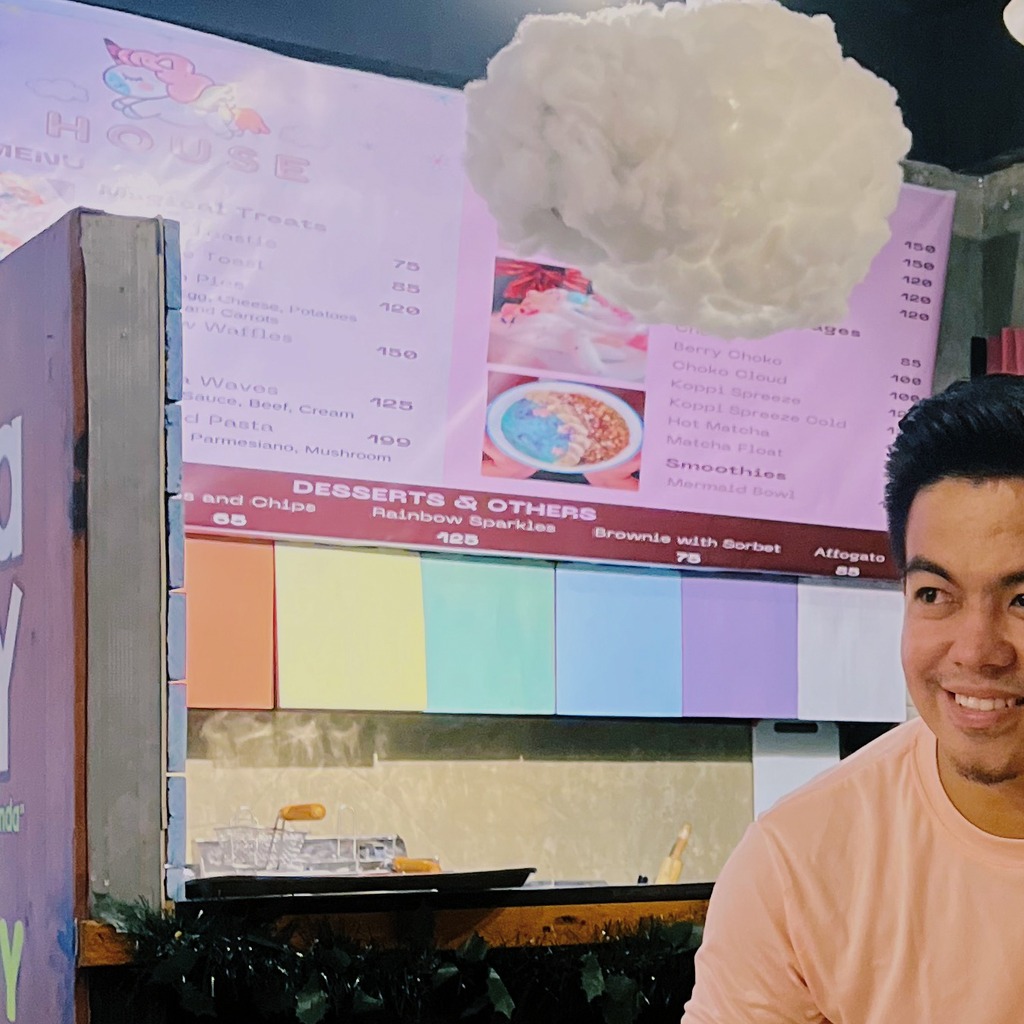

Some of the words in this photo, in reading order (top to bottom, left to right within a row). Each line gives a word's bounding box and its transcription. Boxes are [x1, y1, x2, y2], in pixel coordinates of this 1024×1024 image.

[46, 111, 311, 184] HOUSE
[236, 206, 328, 232] Treats
[904, 241, 936, 254] 150
[393, 259, 420, 272] 75
[903, 259, 935, 271] 150
[902, 276, 932, 288] 120
[187, 291, 213, 303] gg,
[901, 293, 931, 305] 120
[221, 308, 279, 325] Carrots
[379, 302, 420, 316] 120
[900, 309, 929, 321] 120
[205, 321, 292, 343] Waffles
[376, 346, 418, 360] 150
[674, 341, 721, 358] Berry
[728, 350, 782, 366] Choko
[901, 358, 921, 368] 85
[672, 360, 728, 376] Choko
[735, 369, 788, 385] Cloud
[890, 374, 921, 386] 100
[201, 376, 278, 396] Waves
[670, 379, 724, 395] Koppi
[249, 398, 292, 414] Beef,
[299, 404, 355, 420] Cream
[370, 397, 413, 411] 125
[209, 415, 274, 433] Pasta
[668, 416, 699, 429] Hot
[706, 421, 770, 437] Matcha
[806, 415, 847, 429] Cold
[191, 433, 298, 454] Parmesiano,
[305, 445, 392, 462] Mushroom
[367, 434, 411, 448] 199
[666, 435, 731, 452] Matcha
[738, 443, 783, 457] Float
[666, 458, 786, 480] Smoothies
[667, 477, 747, 495] Mermaid
[752, 487, 796, 500] Bowl
[202, 494, 244, 507] and
[252, 496, 317, 513] Chips
[293, 480, 445, 506] DESSERTS
[454, 495, 478, 512] &
[488, 499, 597, 521] OTHERS
[213, 512, 247, 527] 65
[372, 507, 463, 525] Rainbow
[469, 515, 556, 533] Sparkles
[594, 527, 671, 544] Brownie
[677, 535, 718, 548] with
[722, 538, 781, 554] Sorbet
[676, 551, 701, 564] 75
[814, 547, 886, 563] Affogato
